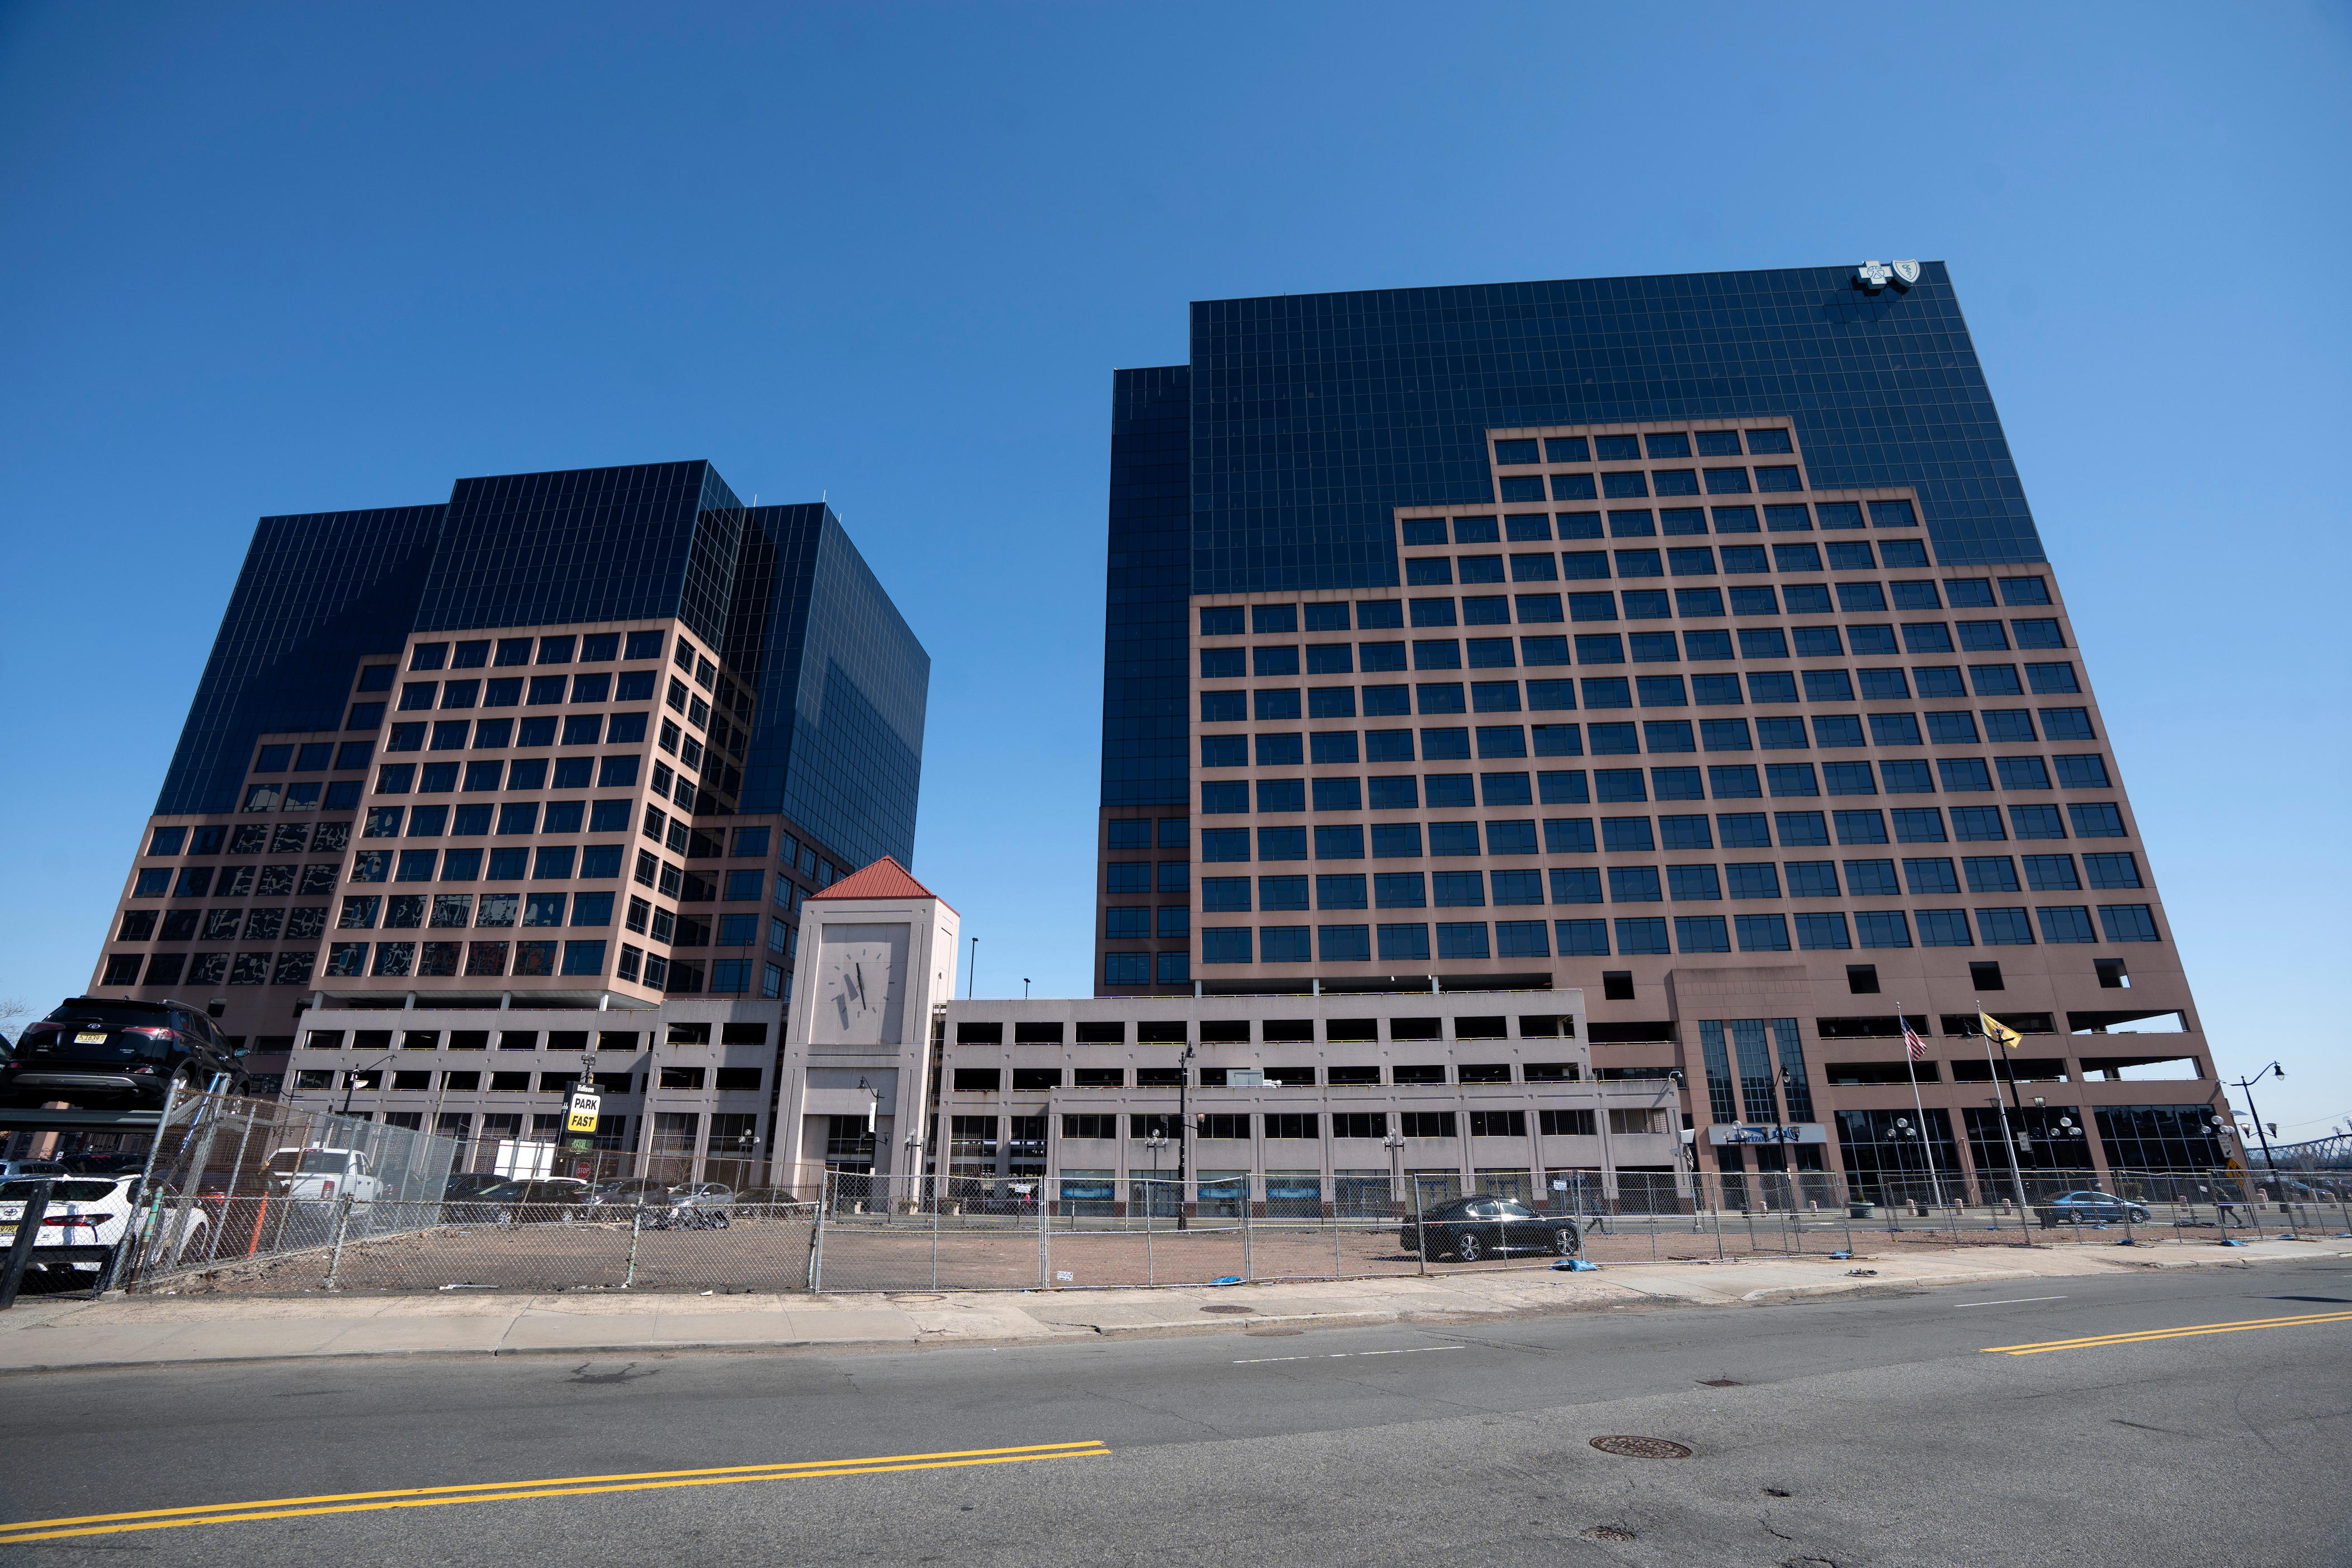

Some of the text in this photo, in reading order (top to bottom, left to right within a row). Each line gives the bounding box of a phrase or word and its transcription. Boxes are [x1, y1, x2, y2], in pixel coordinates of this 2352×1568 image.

[577, 1084, 594, 1093] Edison
[574, 1098, 597, 1110] PARK
[572, 1115, 594, 1127] FAST
